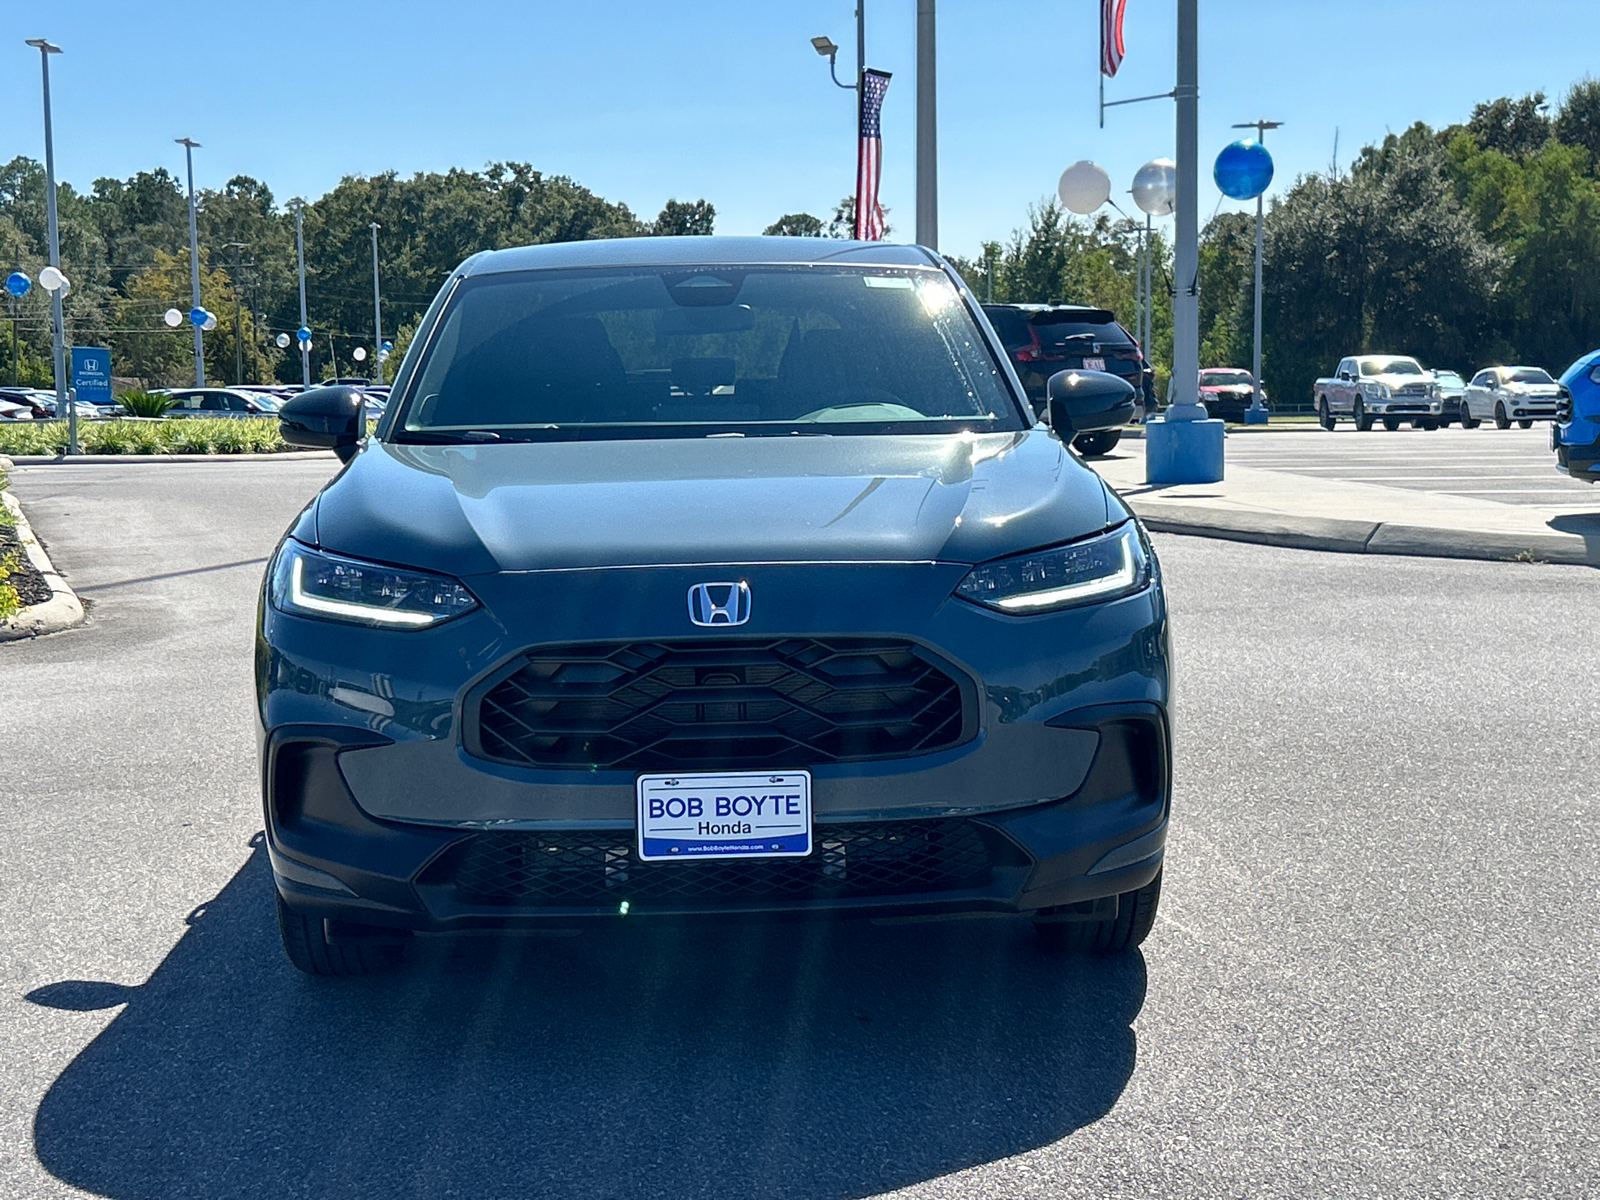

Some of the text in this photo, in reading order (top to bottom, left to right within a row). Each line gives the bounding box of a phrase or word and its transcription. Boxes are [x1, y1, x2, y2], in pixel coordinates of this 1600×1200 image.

[649, 795, 801, 819] BOB BOYTE
[698, 821, 752, 835] Honda
[687, 844, 765, 853] www.BobBoyteHonda.com
